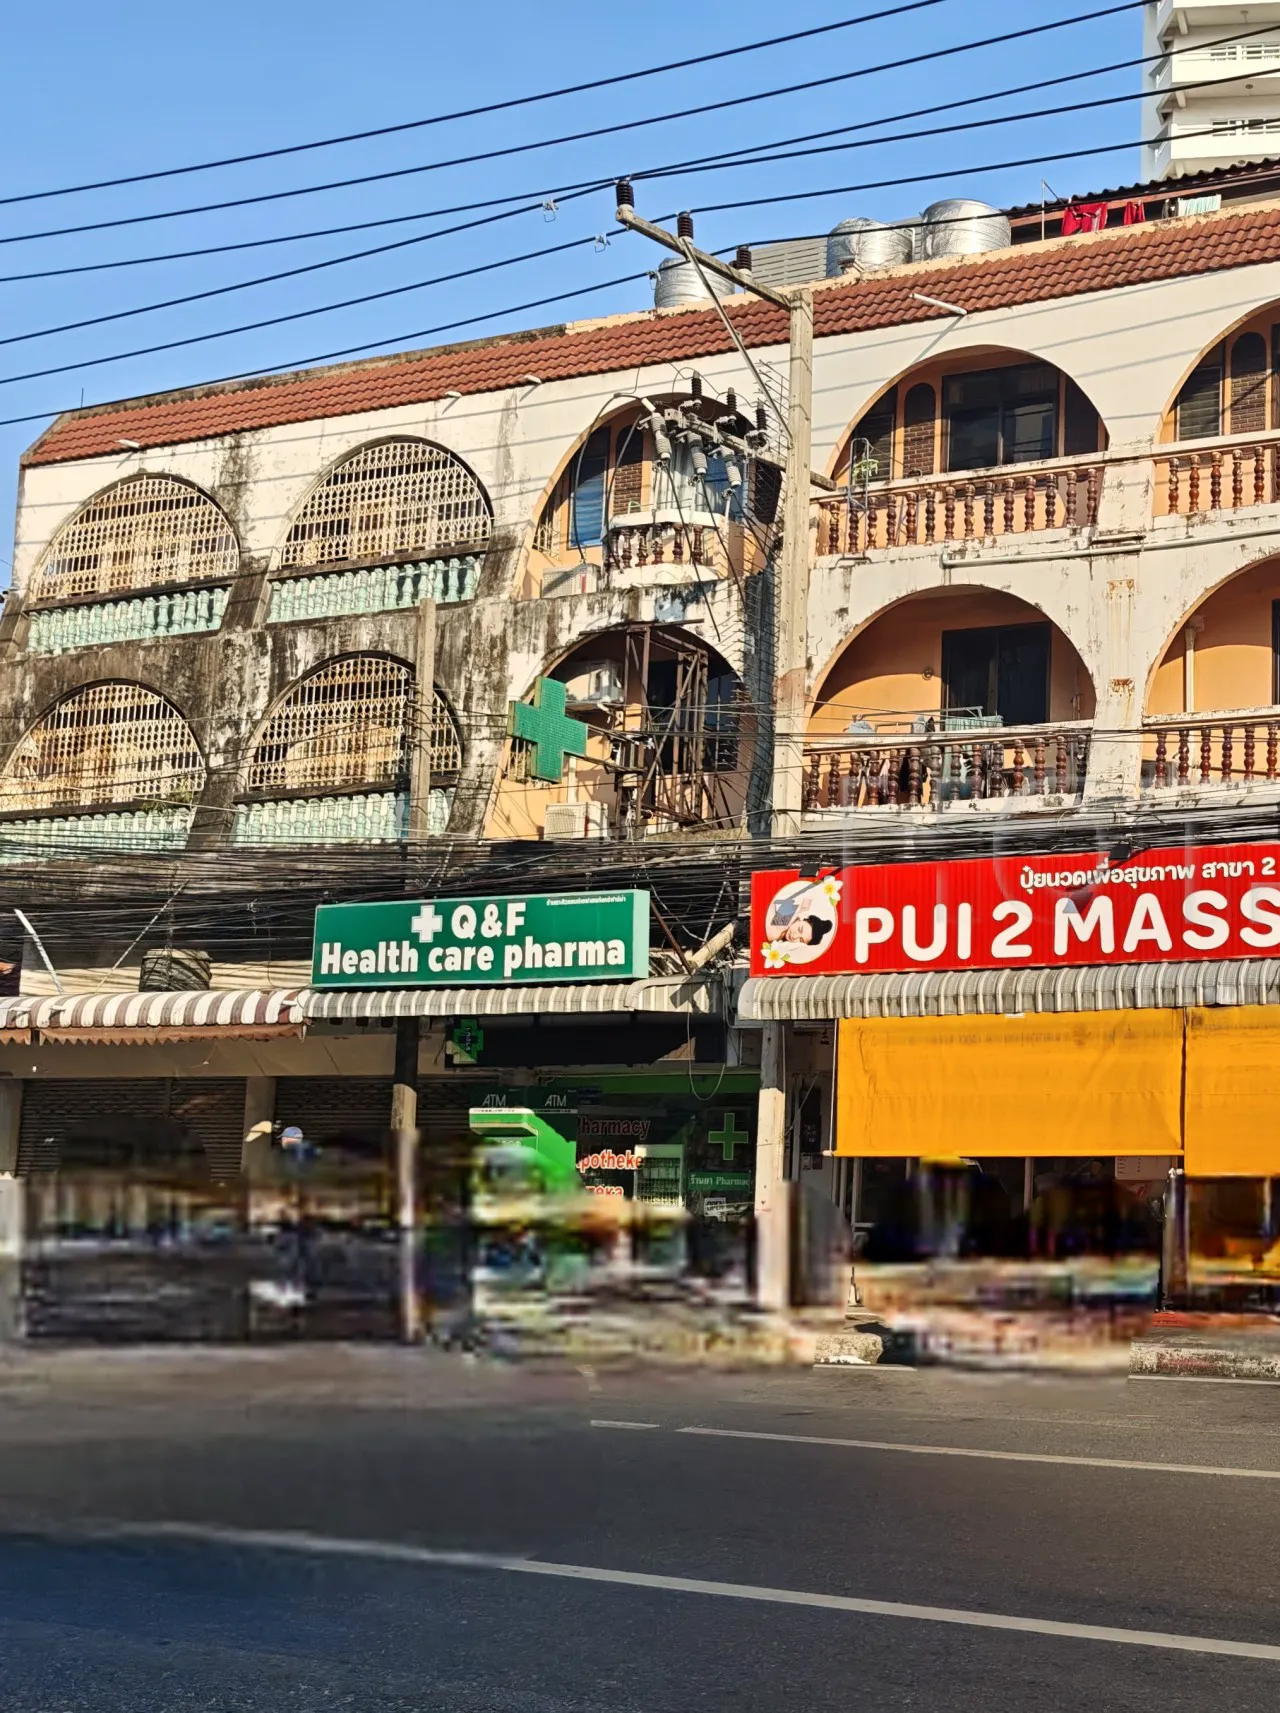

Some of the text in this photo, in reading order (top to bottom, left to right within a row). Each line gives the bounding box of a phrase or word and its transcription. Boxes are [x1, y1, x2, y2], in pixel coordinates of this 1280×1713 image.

[1020, 857, 1276, 894] ปุ๋ยนวดเพื่อสุขภาพ สาขา 2
[452, 902, 526, 940] Q&F
[855, 902, 972, 963] PUI
[991, 900, 1033, 958] 2
[321, 935, 626, 977] Health care pharma
[482, 1094, 507, 1107] ATM
[545, 1095, 567, 1107] ATM
[578, 1115, 651, 1141] harmacy
[576, 1149, 644, 1174] potheke
